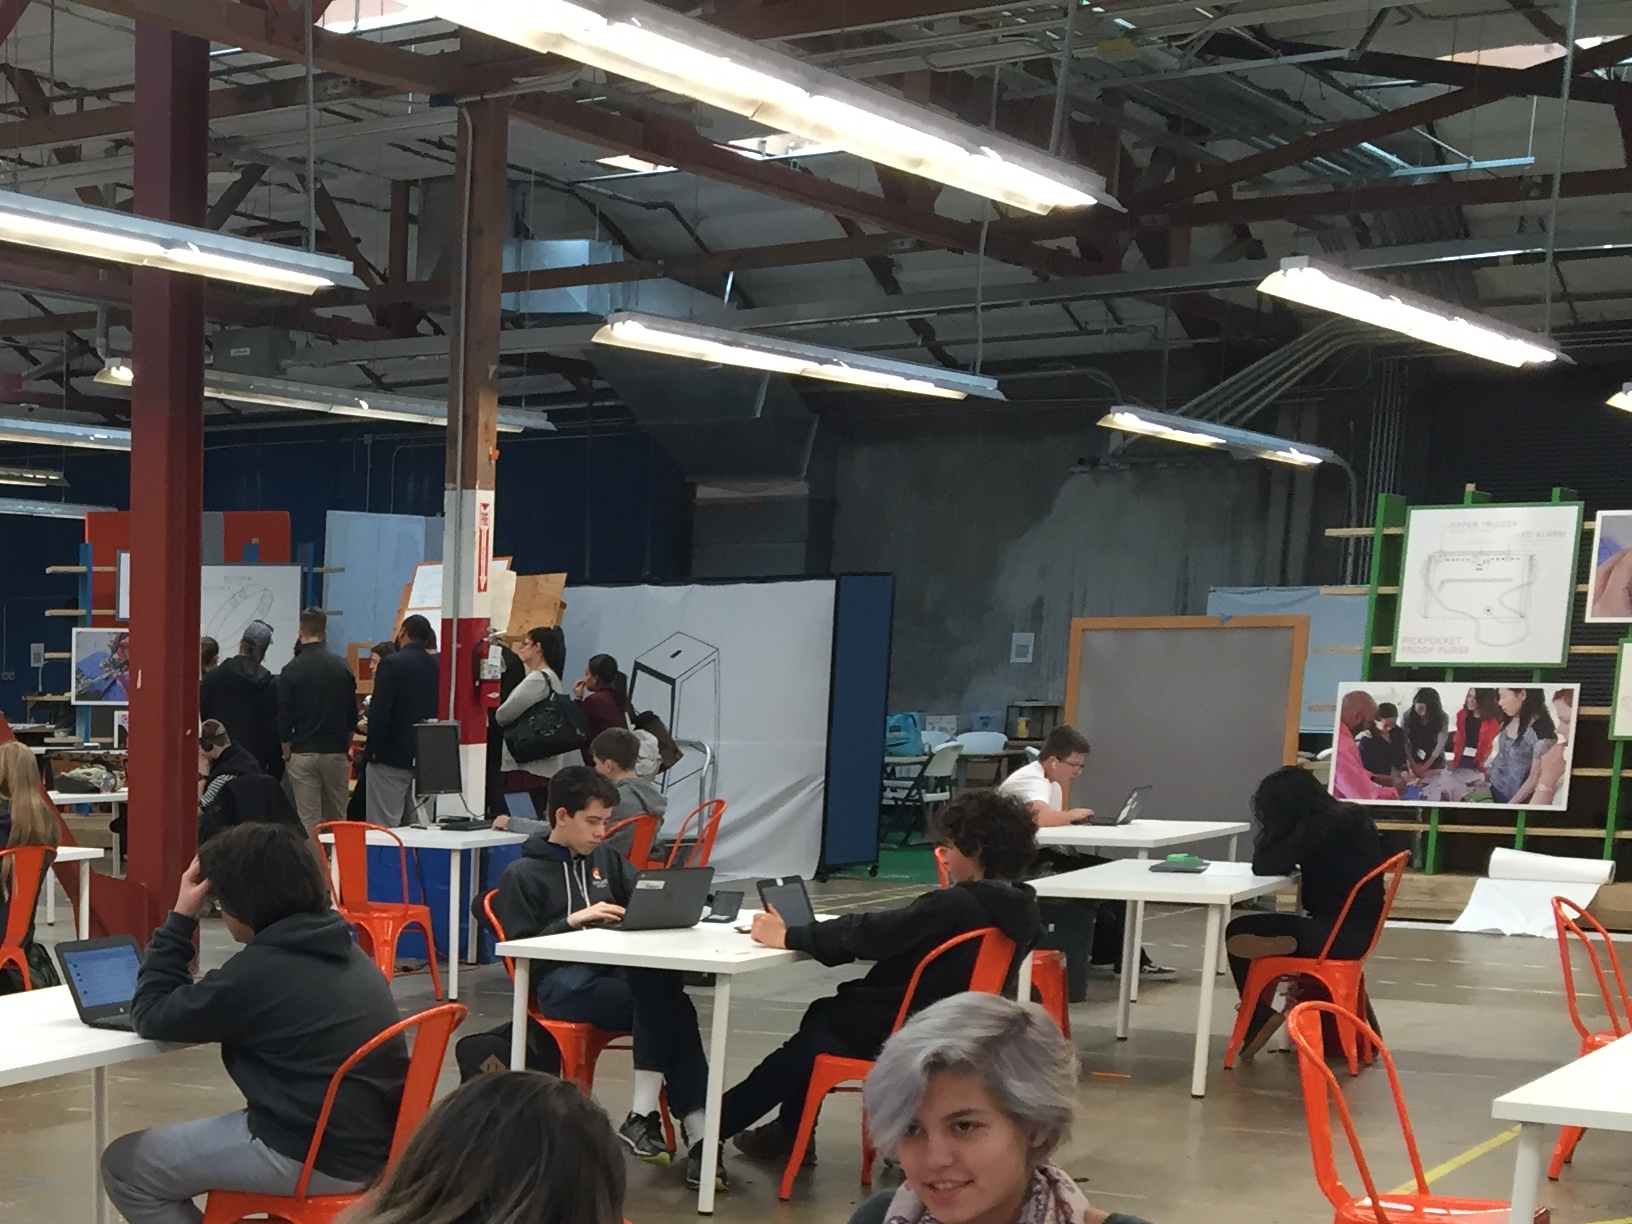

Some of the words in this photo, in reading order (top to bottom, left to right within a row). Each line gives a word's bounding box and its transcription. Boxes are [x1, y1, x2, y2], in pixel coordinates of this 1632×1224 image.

[1402, 636, 1462, 645] PICKPOCKET
[1401, 646, 1434, 655] PROOF
[1438, 646, 1470, 655] PURSE
